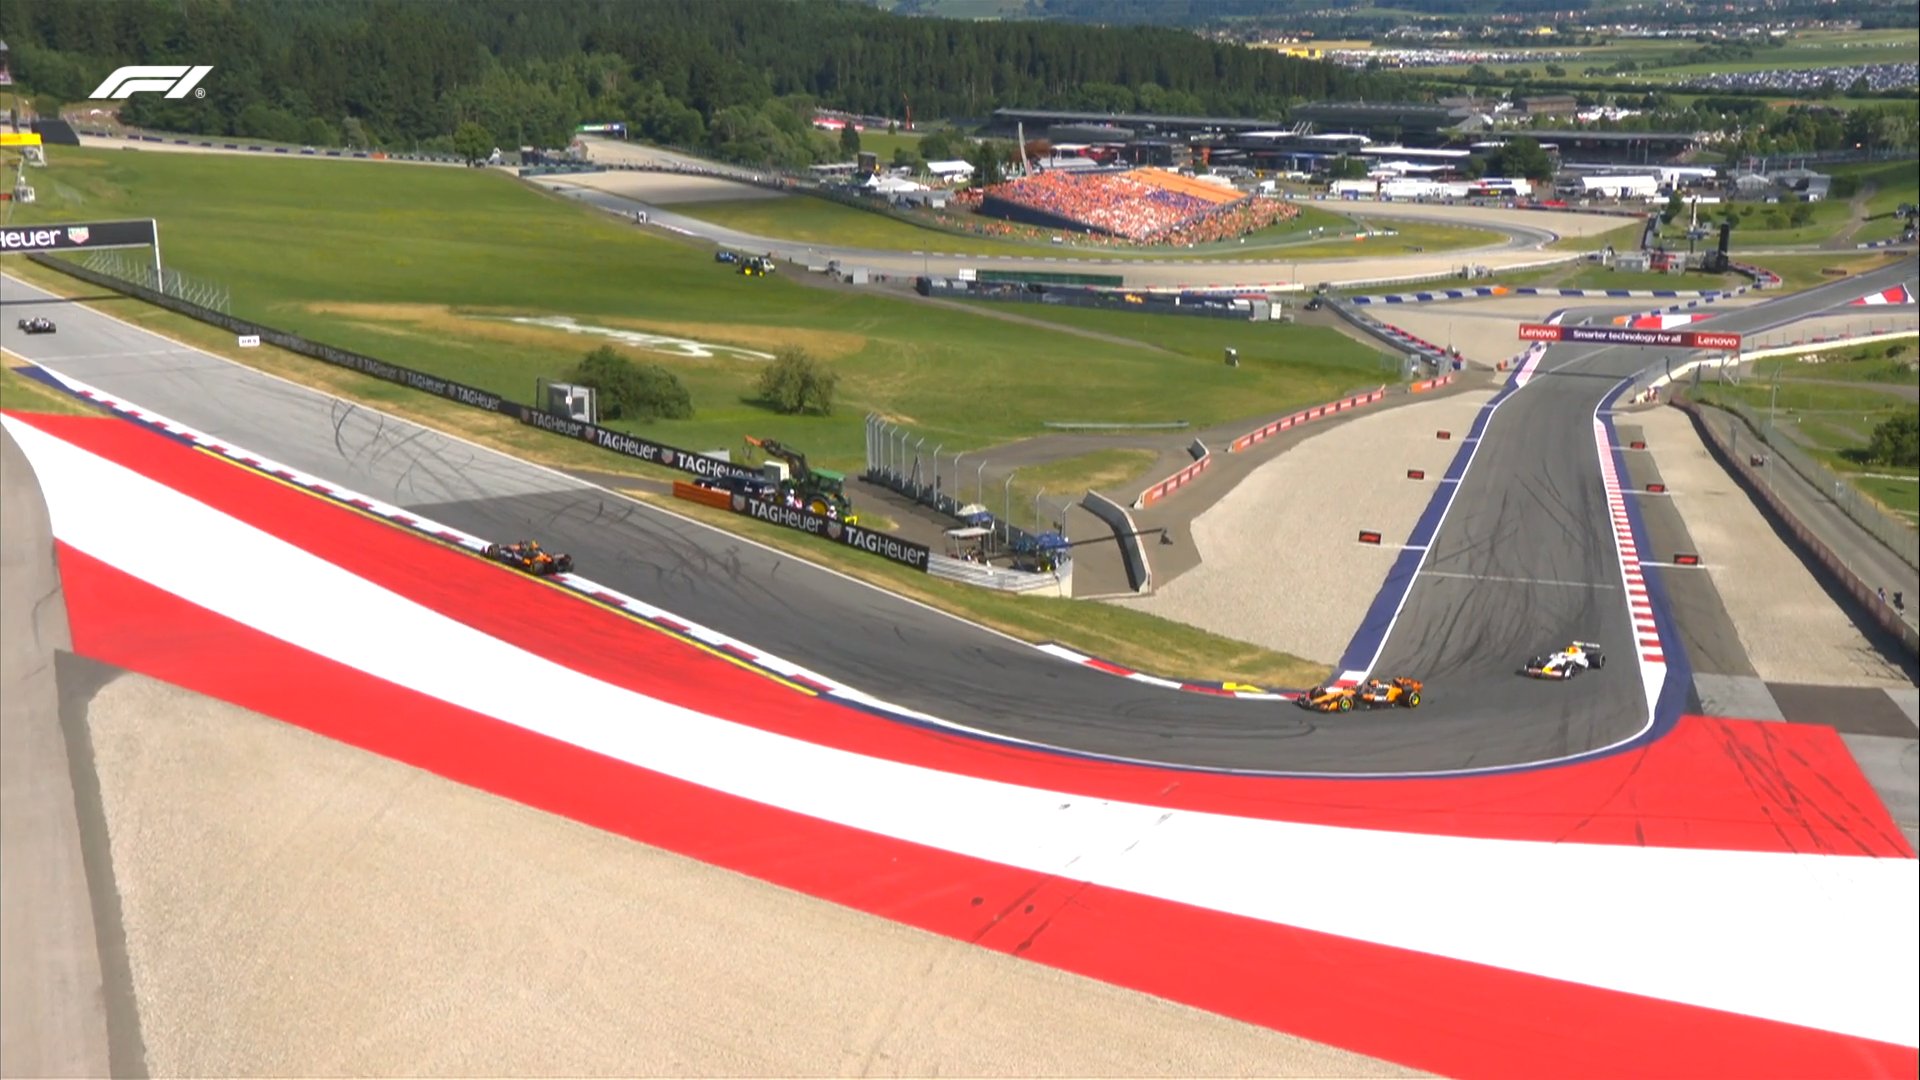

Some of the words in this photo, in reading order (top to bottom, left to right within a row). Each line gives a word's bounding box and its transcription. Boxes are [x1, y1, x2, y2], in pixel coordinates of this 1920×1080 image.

[1520, 327, 1558, 339] Lenovo
[1573, 330, 1607, 340] Smarter
[1608, 331, 1656, 343] technology
[1657, 333, 1671, 343] for
[1671, 334, 1682, 343] all
[1697, 335, 1737, 347] Lenovo
